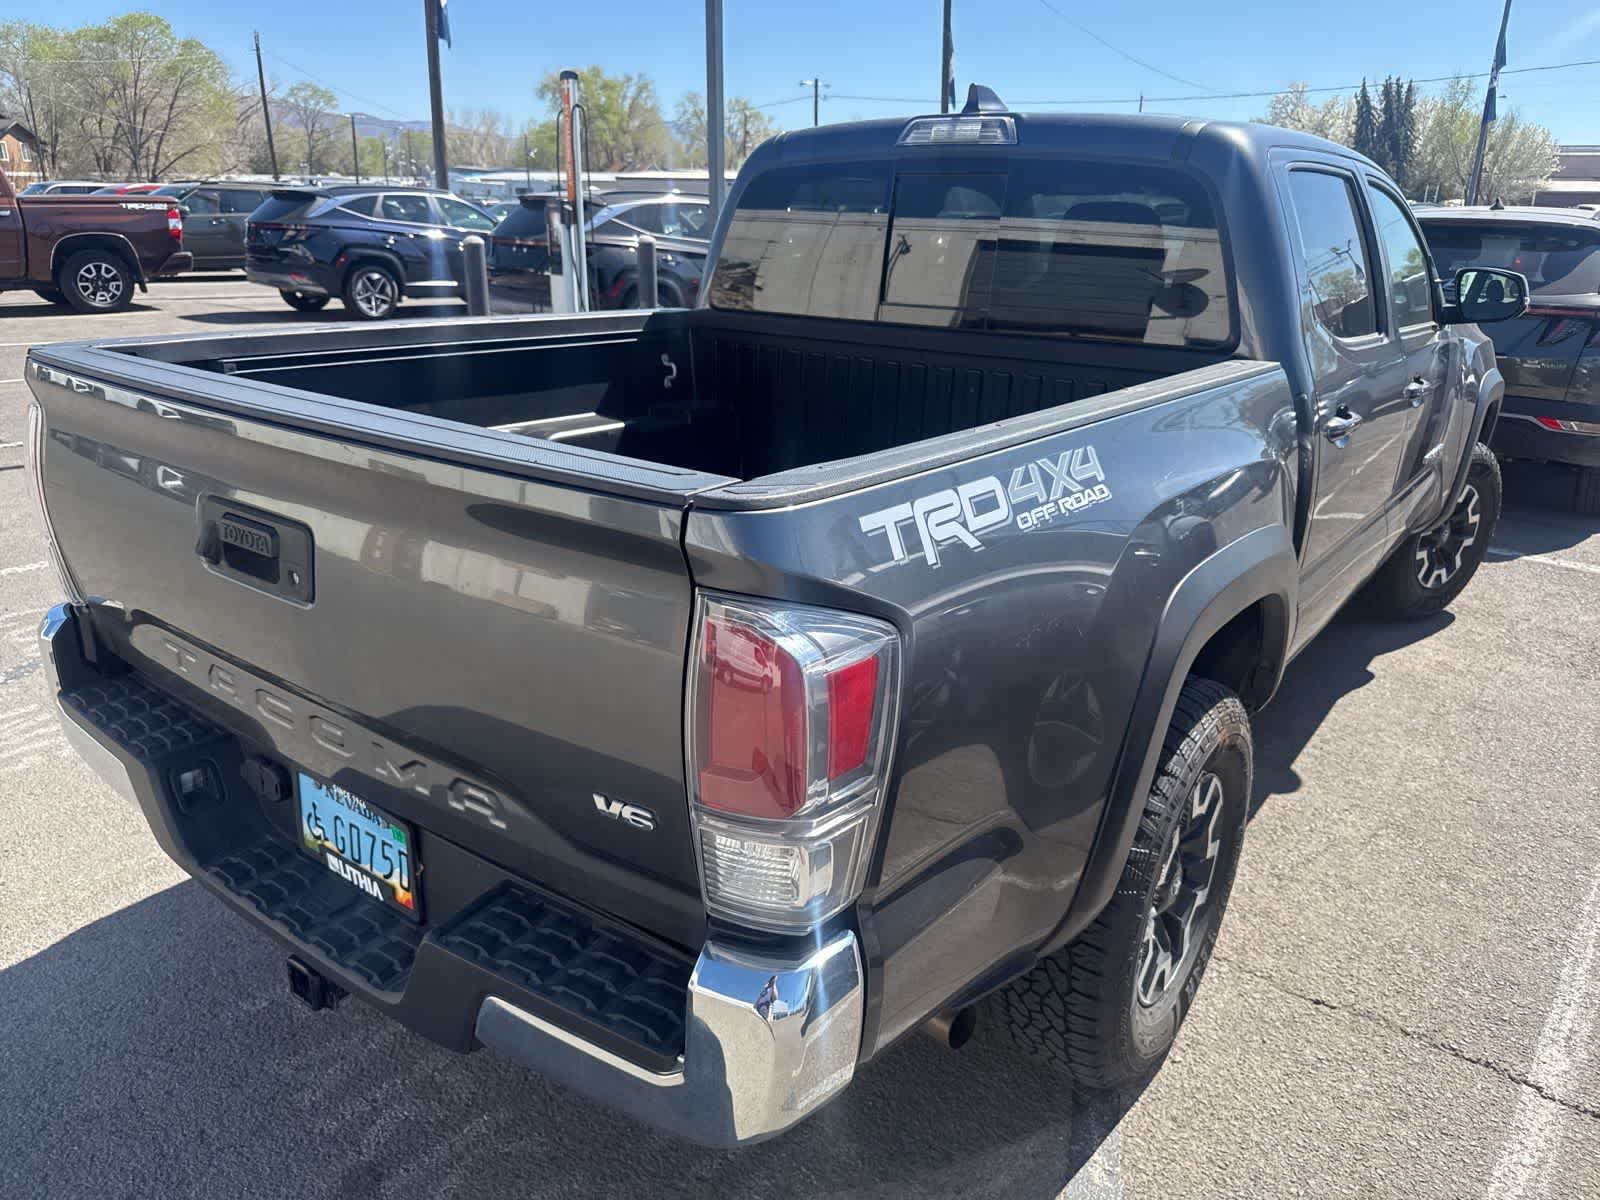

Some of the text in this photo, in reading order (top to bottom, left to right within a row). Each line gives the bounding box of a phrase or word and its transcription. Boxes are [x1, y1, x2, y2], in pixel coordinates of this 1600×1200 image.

[858, 475, 1013, 569] TRD
[1016, 483, 1112, 532] OFF ROAD
[222, 523, 271, 555] TOYOTA
[162, 637, 507, 829] TACOMA
[592, 792, 654, 831] V6
[338, 857, 384, 901] LITHIA
